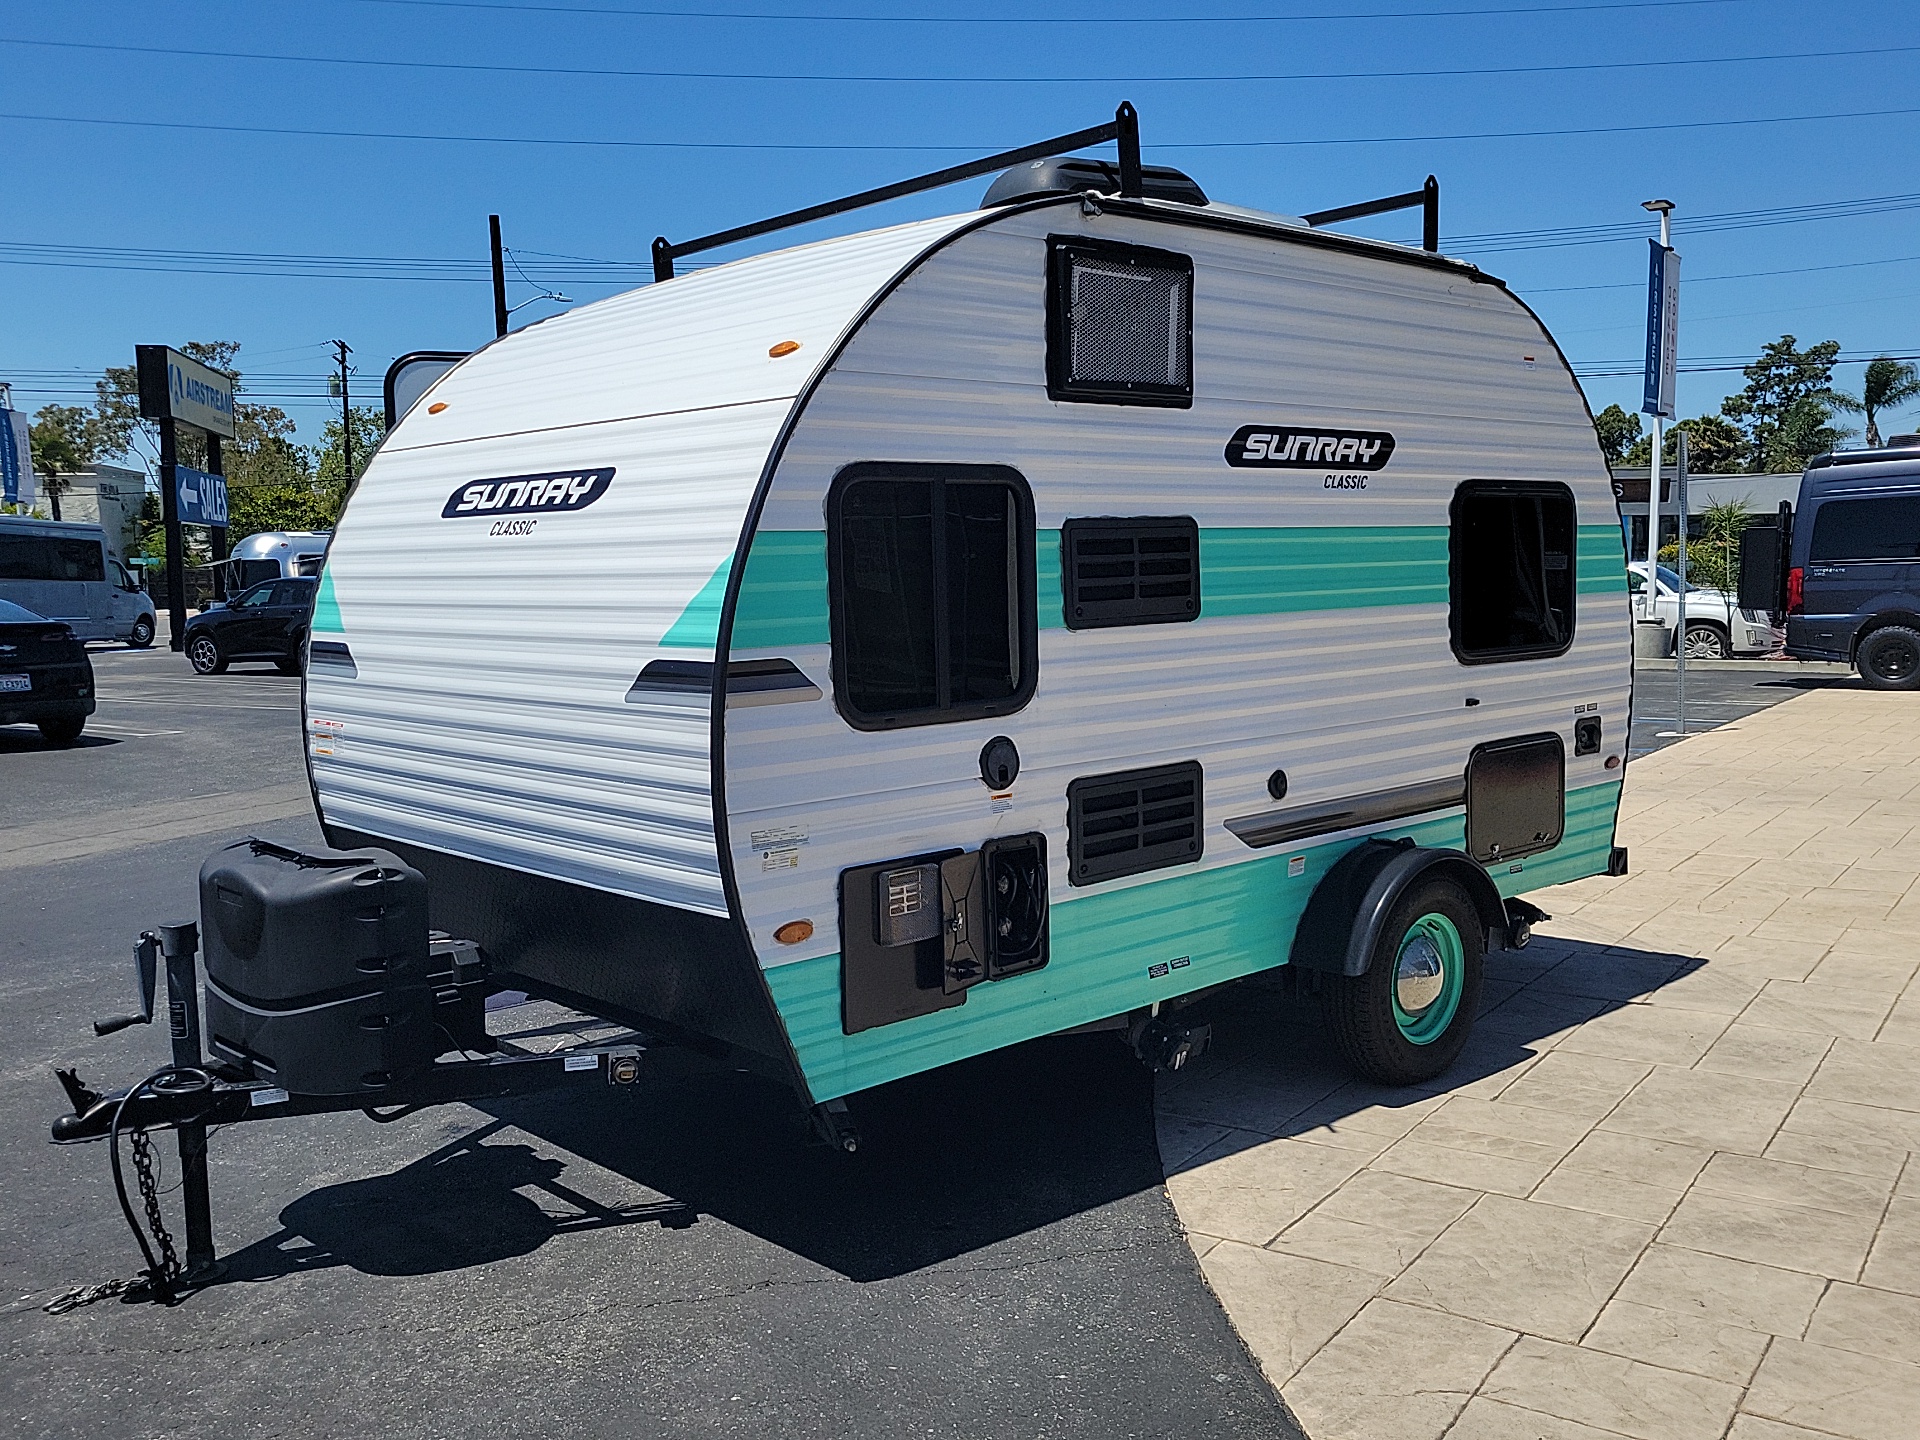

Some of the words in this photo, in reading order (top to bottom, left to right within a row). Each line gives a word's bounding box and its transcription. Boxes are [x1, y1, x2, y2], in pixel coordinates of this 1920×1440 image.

[1650, 262, 1659, 385] AIRSTREAM
[186, 376, 232, 415] AIRSTREAM
[1242, 433, 1381, 463] SUNRAY
[199, 476, 228, 523] SALES
[456, 475, 598, 512] SUNRAY
[1323, 474, 1368, 490] CLASSIC
[489, 520, 537, 537] CLASSIC
